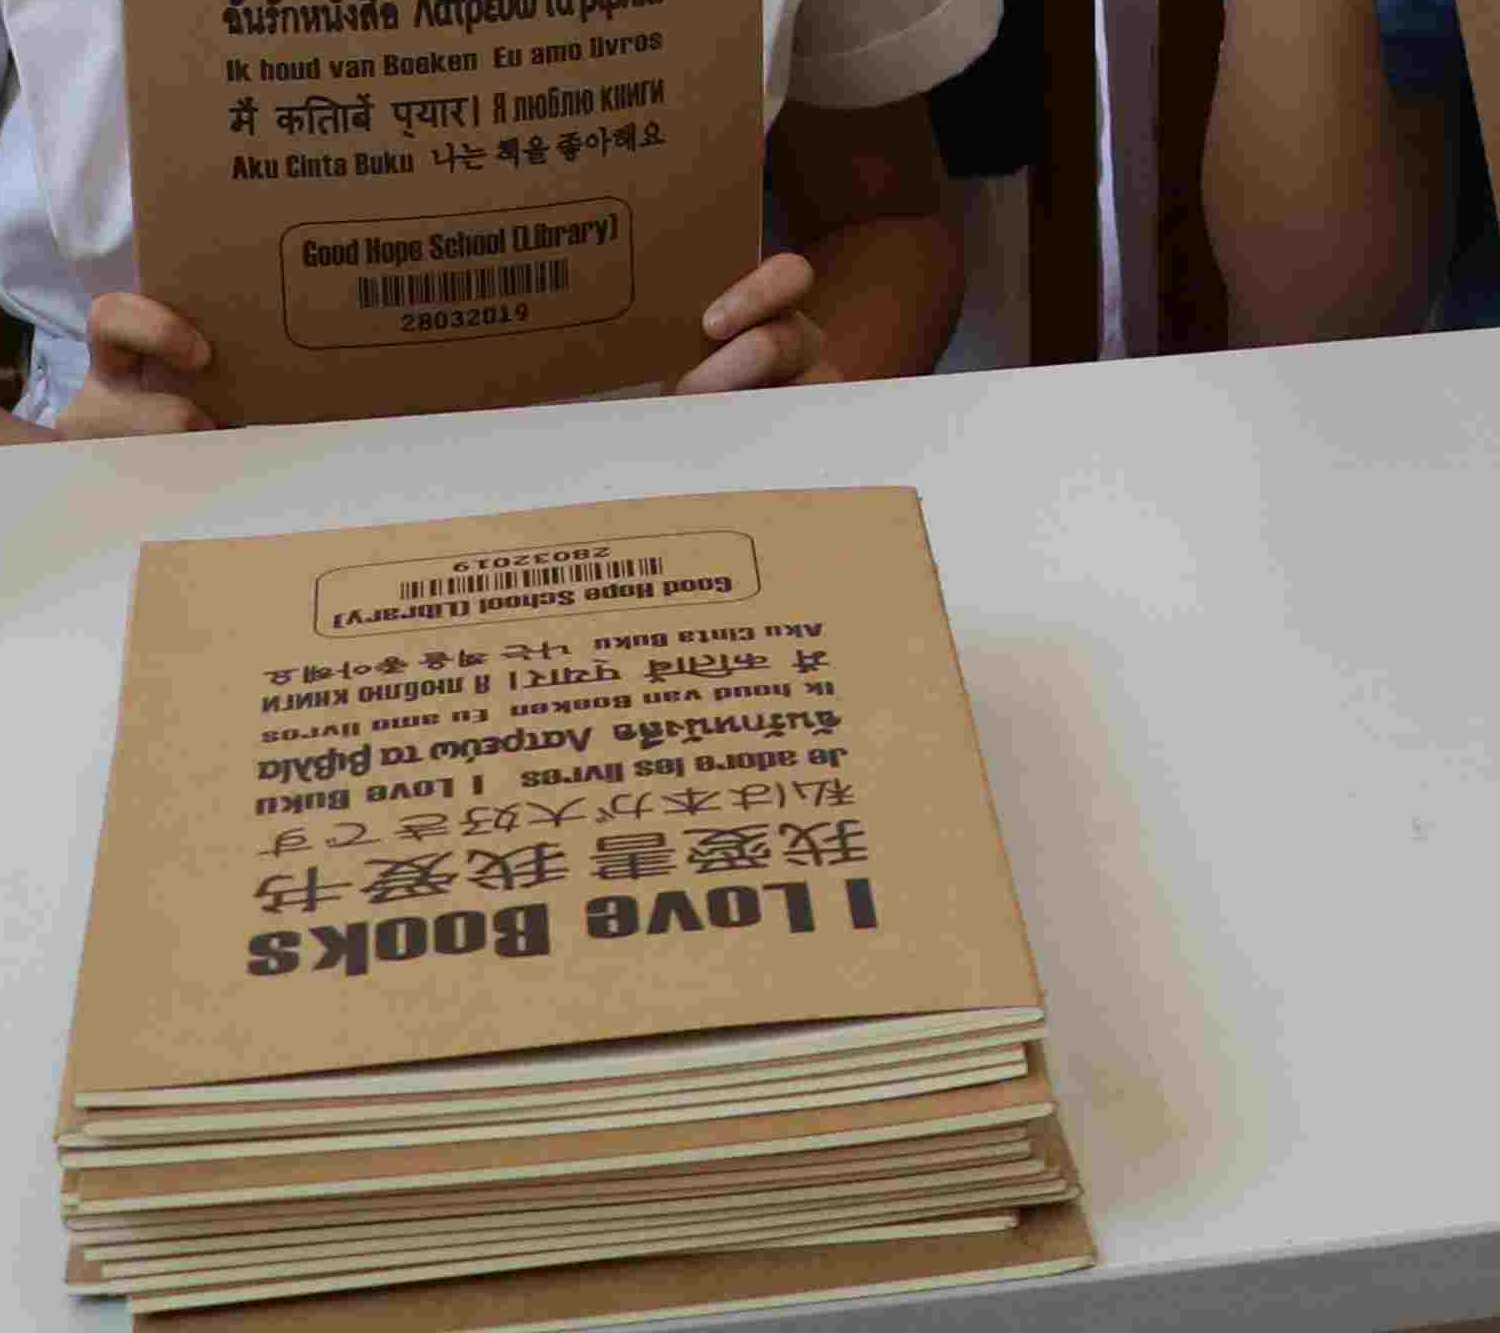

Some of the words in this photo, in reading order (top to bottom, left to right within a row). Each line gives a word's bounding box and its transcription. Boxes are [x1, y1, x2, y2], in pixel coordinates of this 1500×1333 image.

[226, 59, 251, 81] Ik
[259, 57, 320, 81] houd
[329, 59, 374, 78] van
[383, 52, 477, 76] Boeken
[493, 46, 522, 69] Eu
[531, 42, 582, 64] amo
[589, 31, 662, 58] livros
[232, 156, 279, 180] Aku
[285, 154, 348, 178] Cinta
[354, 150, 414, 175] Buku
[302, 238, 359, 267] Good
[364, 236, 423, 267] Hope
[428, 228, 506, 260] School
[512, 212, 617, 252] (Library)
[401, 303, 529, 333] 28032019
[452, 547, 610, 573] 28032019
[478, 589, 574, 613] School
[583, 582, 654, 600] Hope
[662, 576, 731, 596] Good
[332, 600, 469, 628] (Library)
[257, 777, 854, 857] 私は本が大好きです
[589, 819, 867, 879] 我愛書
[253, 842, 568, 913] 我爱书
[585, 880, 815, 939] Love
[843, 877, 877, 929] I
[247, 902, 550, 976] Books
